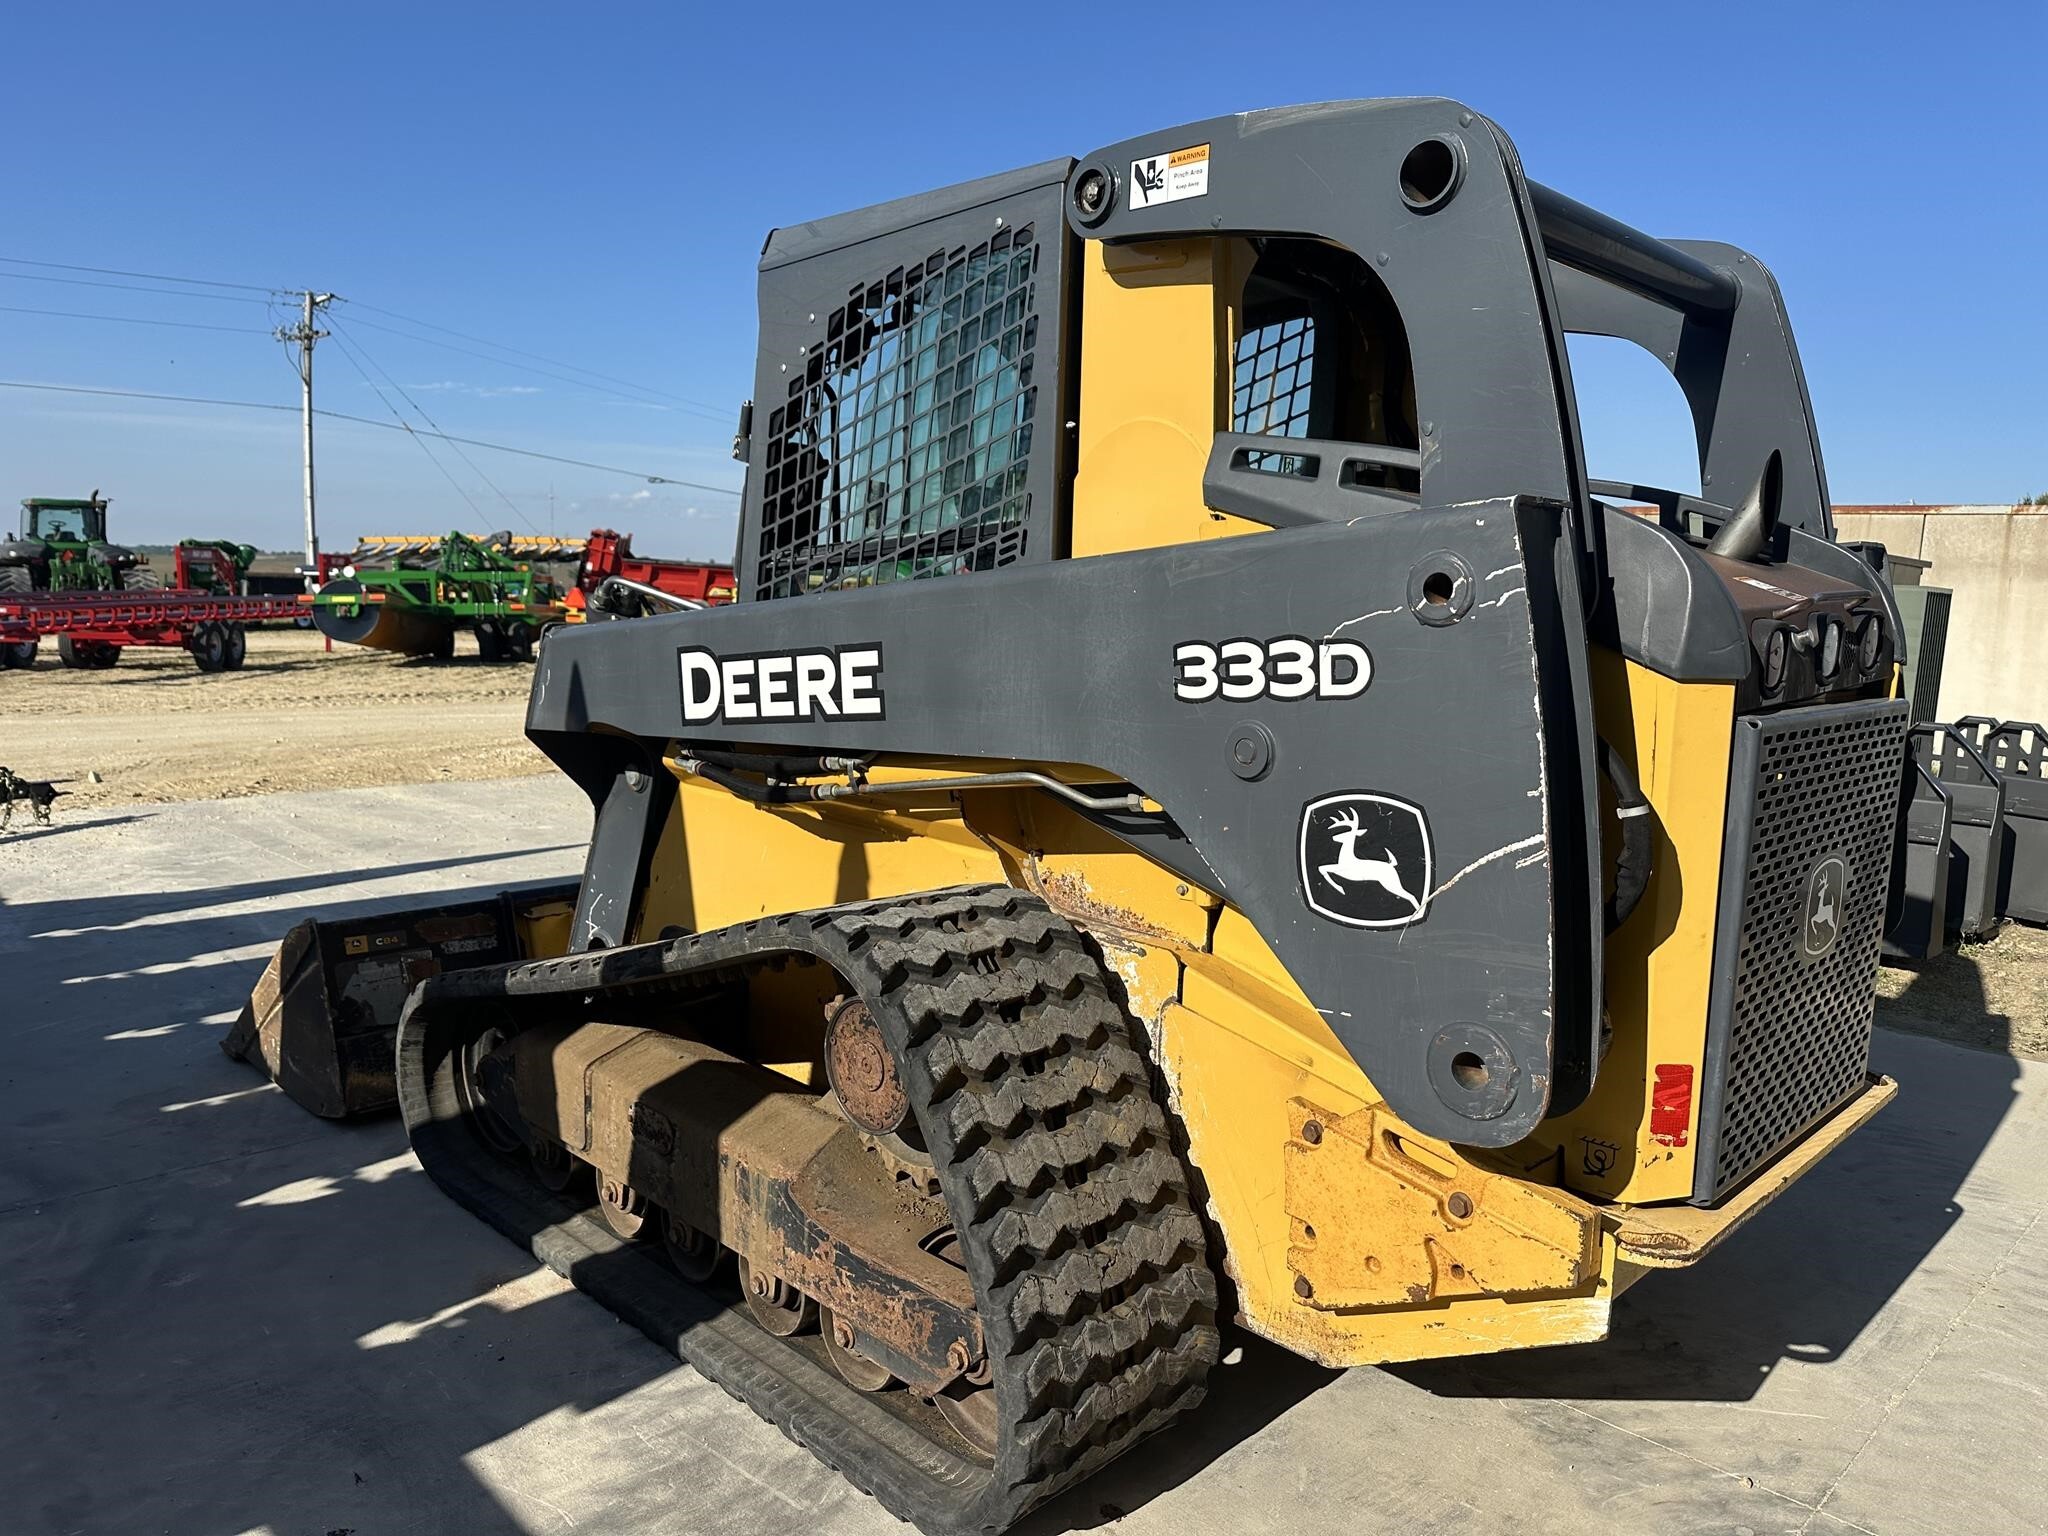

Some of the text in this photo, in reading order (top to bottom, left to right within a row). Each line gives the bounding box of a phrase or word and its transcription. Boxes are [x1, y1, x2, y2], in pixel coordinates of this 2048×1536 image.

[1177, 150, 1206, 162] WARNING
[679, 650, 882, 720] DEERE
[1177, 640, 1372, 699] 333D
